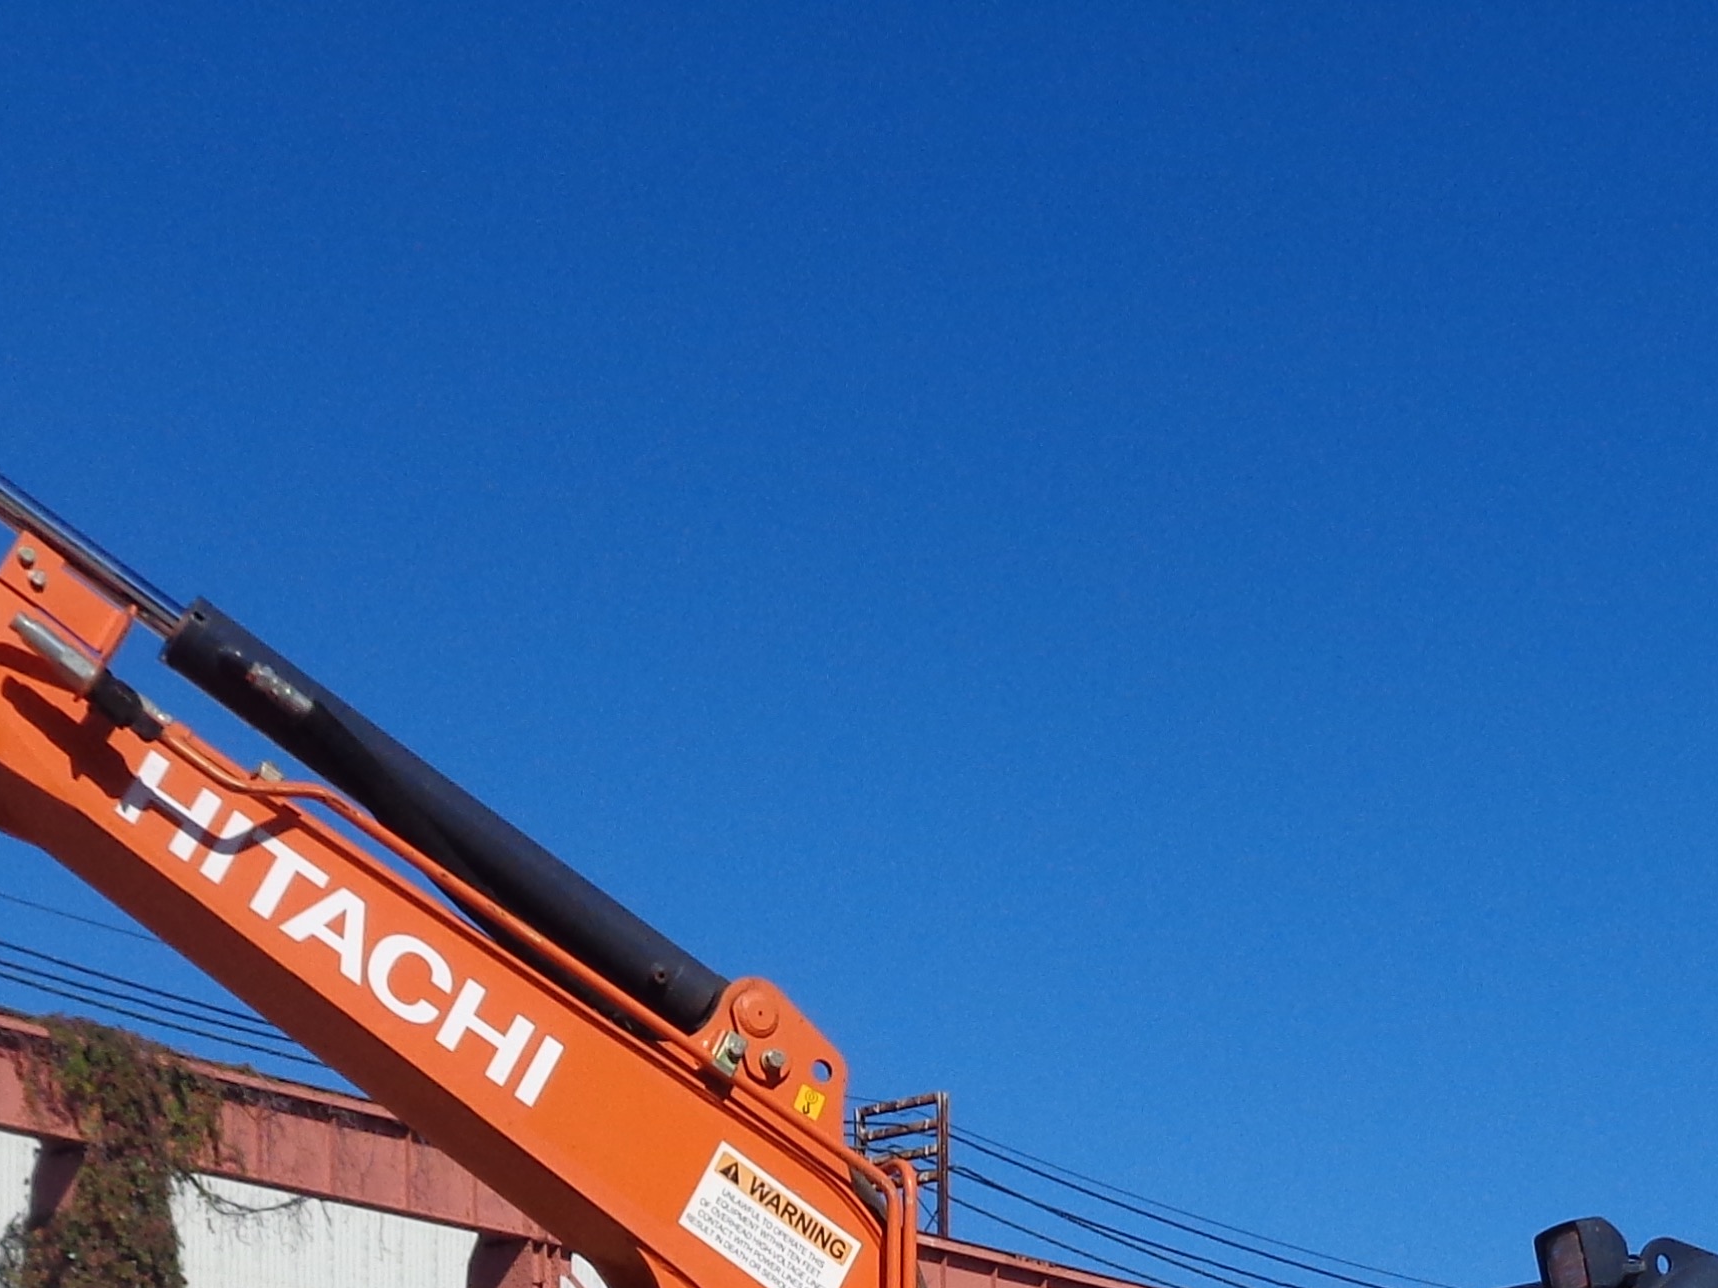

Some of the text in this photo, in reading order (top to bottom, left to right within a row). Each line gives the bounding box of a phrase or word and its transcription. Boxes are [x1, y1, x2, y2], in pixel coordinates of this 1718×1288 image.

[114, 751, 564, 1108] HITACHI
[686, 1212, 714, 1236] RESULT
[715, 1233, 723, 1243] IN
[723, 1240, 749, 1261] DEATH
[748, 1258, 761, 1271] OR
[697, 1208, 733, 1237] CONTACT
[733, 1234, 753, 1252] WITH
[753, 1249, 781, 1272] POWER
[781, 1270, 803, 1288] LINES
[699, 1196, 710, 1208] OF
[710, 1205, 752, 1238] OVERHEAD
[716, 1195, 821, 1277] EQUIPMENT WITHIN TEN FEET
[721, 1187, 825, 1267] UNLAWFUL TO OPERATE THIS
[749, 1175, 846, 1260] WARNING
